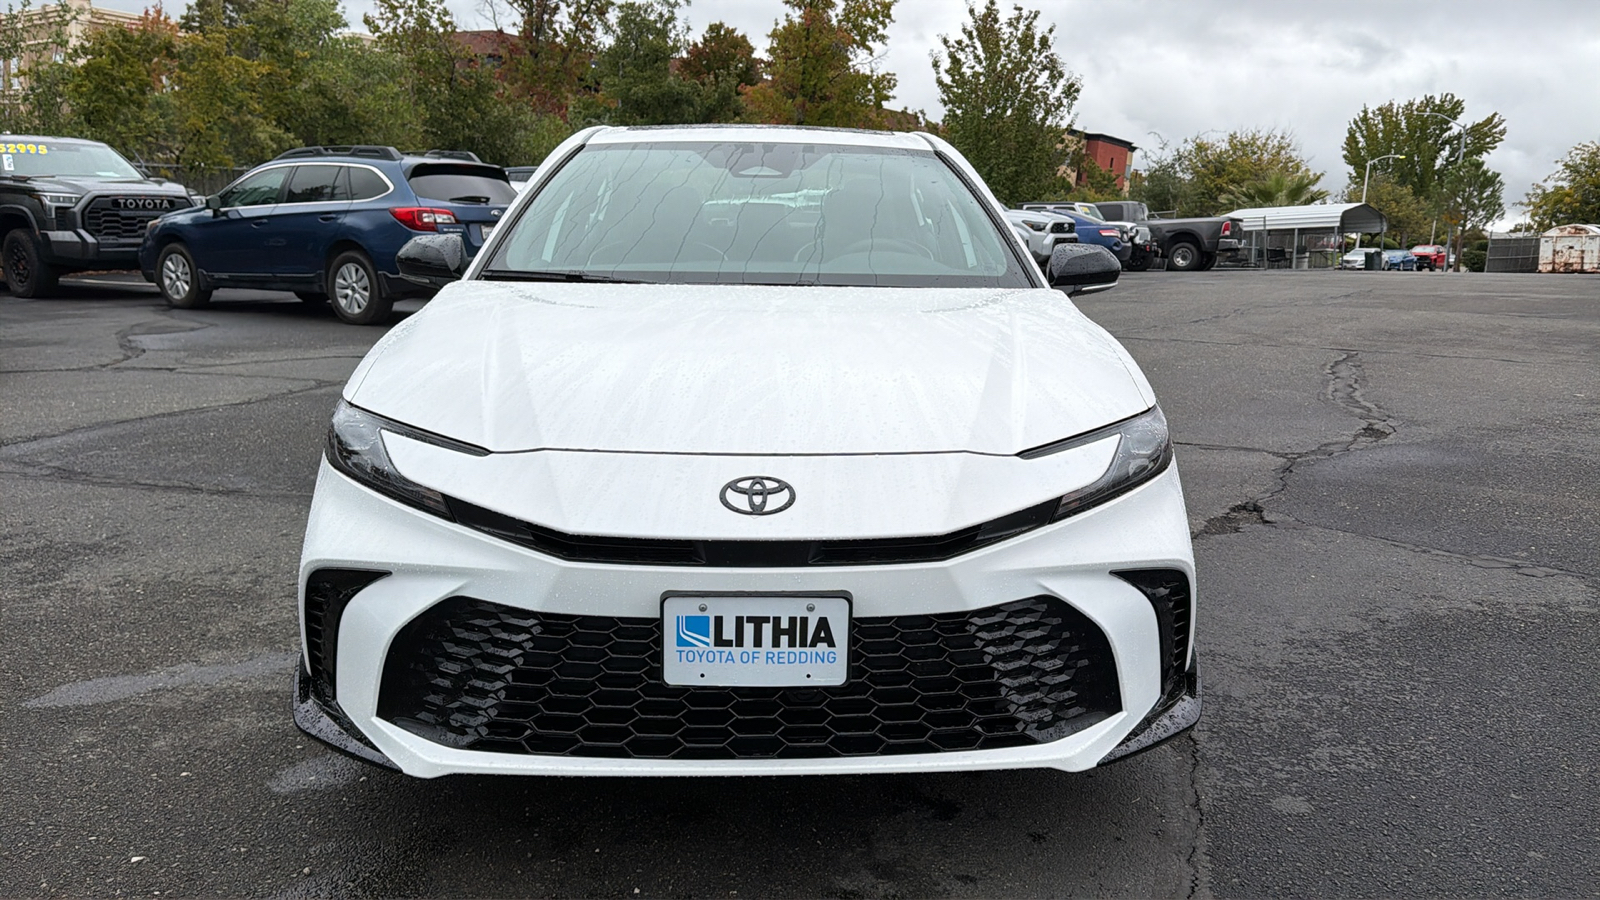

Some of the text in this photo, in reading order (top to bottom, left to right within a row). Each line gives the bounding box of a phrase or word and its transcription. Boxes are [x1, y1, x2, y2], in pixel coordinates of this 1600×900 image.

[118, 199, 171, 209] TOYOTA
[713, 615, 837, 648] LITHIA
[676, 650, 837, 665] TOYOTA OF REDDING
